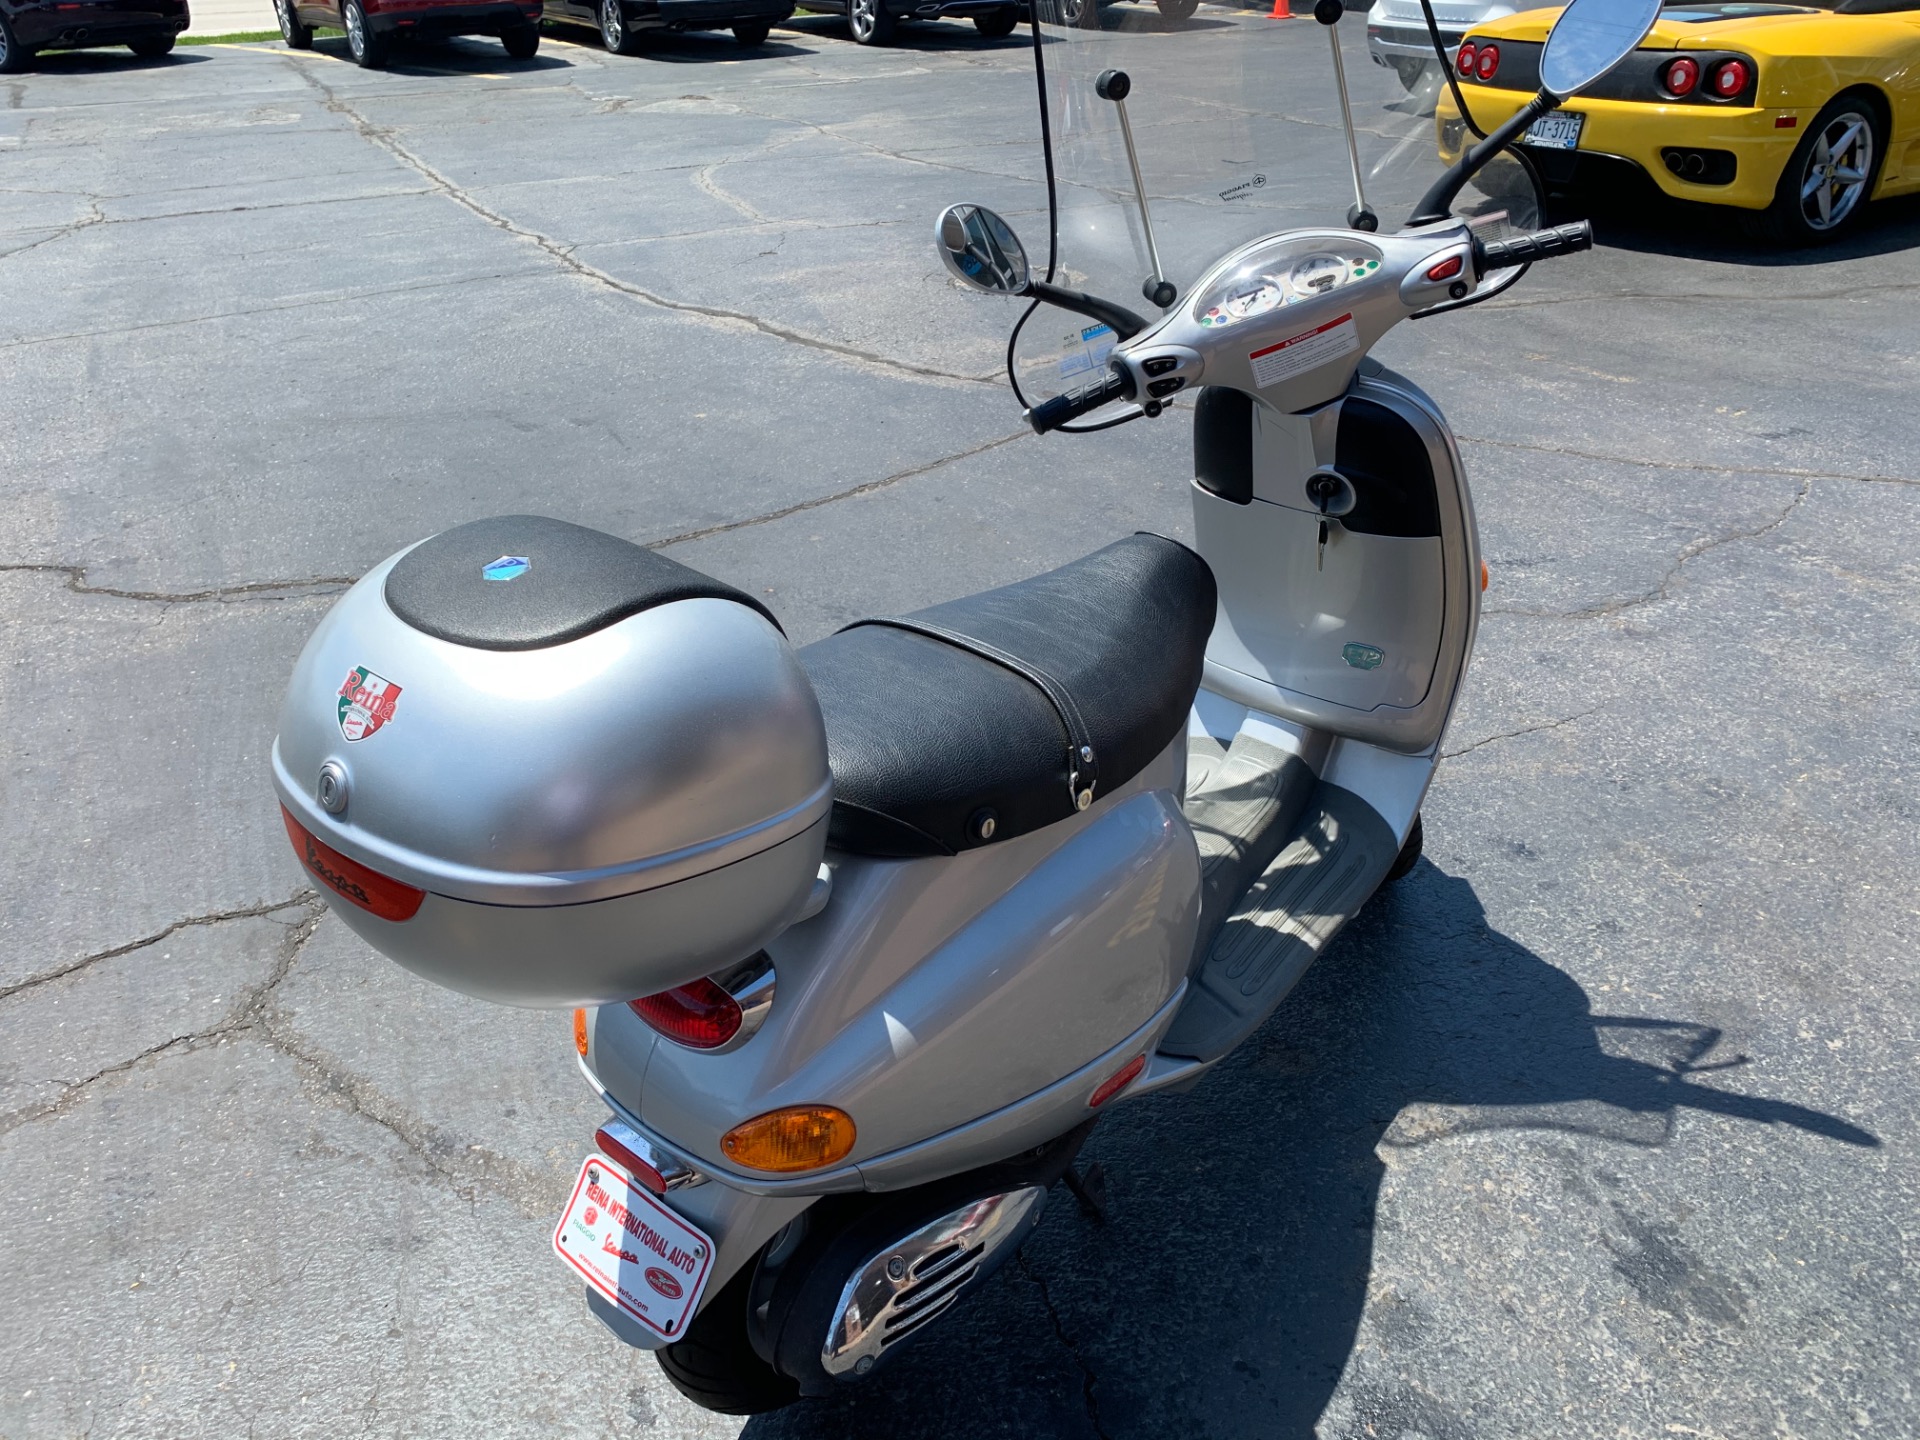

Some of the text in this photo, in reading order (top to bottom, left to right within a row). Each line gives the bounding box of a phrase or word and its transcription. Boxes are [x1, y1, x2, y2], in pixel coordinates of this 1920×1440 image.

[338, 669, 397, 722] Reina
[305, 836, 372, 904] Vespa
[572, 1218, 596, 1242] PIAGGIO
[585, 1182, 696, 1275] REINA INTERNATIONAL AUTO
[601, 1232, 640, 1265] Vespa
